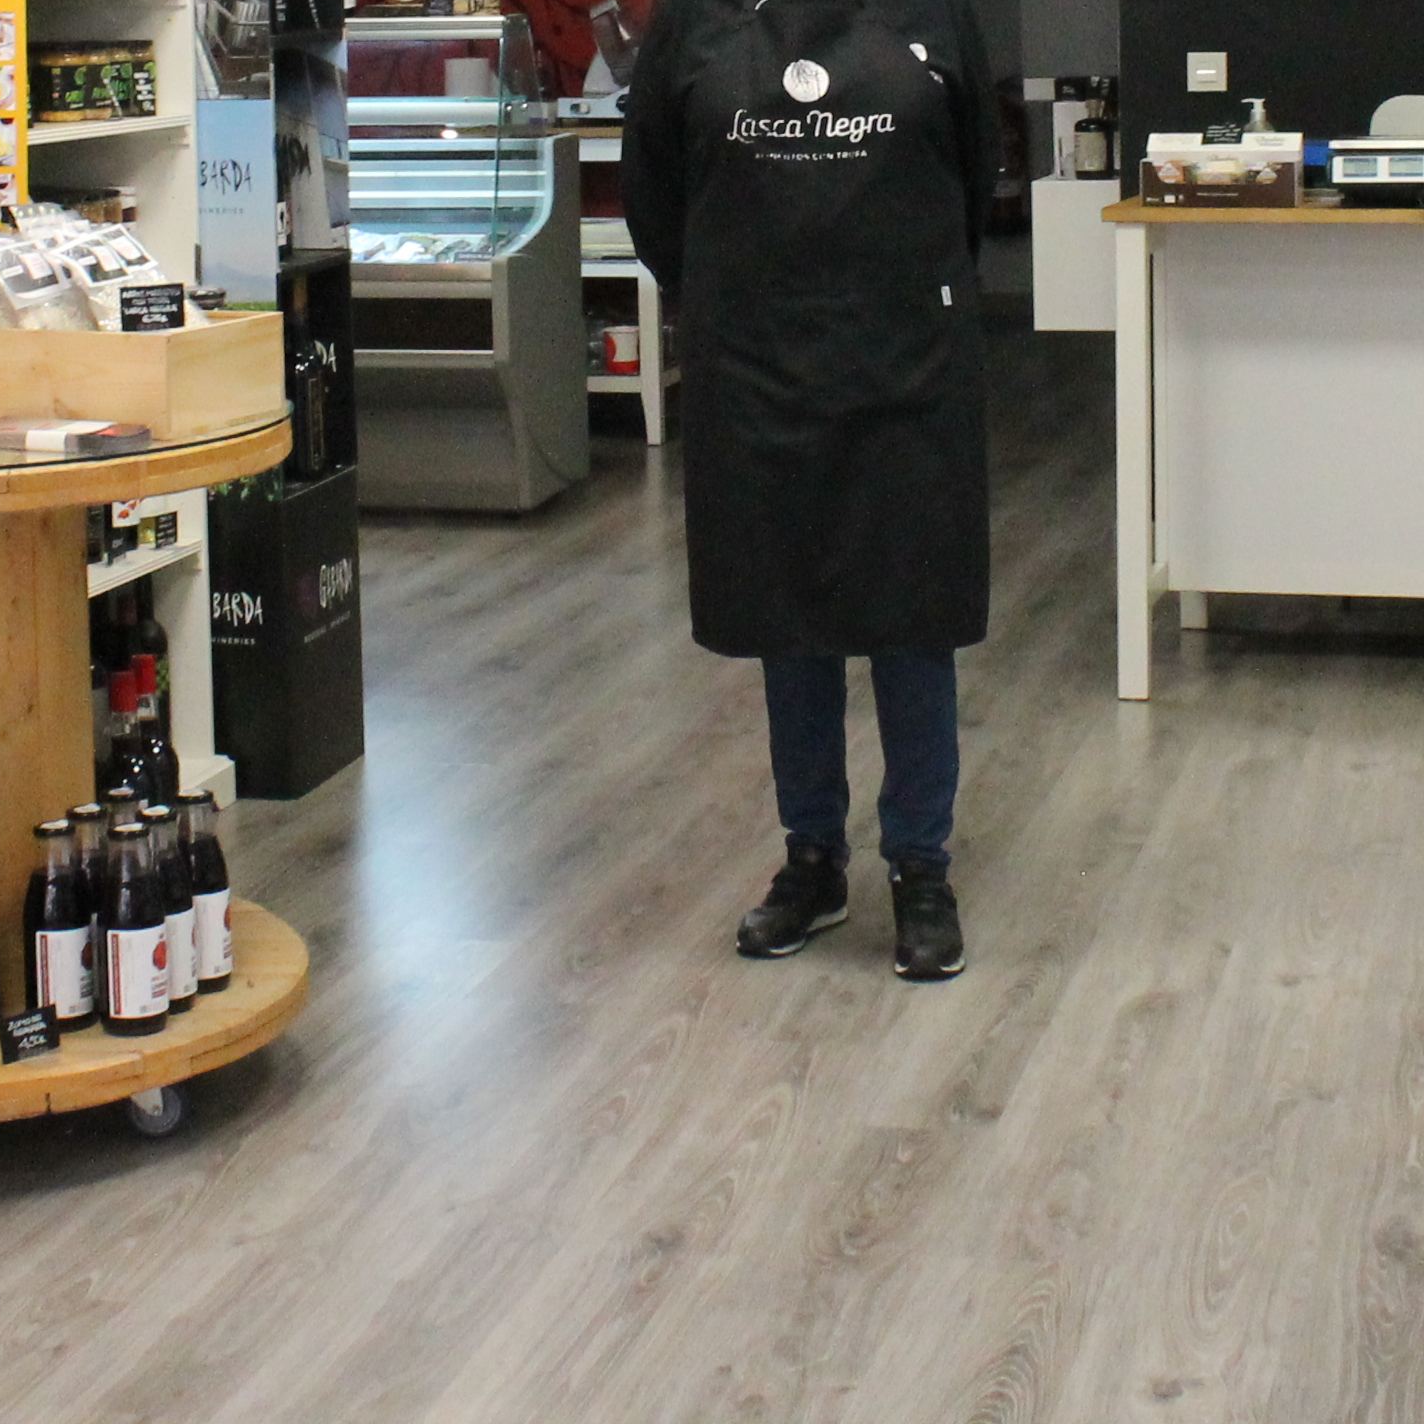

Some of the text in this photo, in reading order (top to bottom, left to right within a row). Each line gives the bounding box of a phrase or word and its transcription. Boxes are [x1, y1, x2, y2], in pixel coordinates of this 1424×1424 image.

[727, 108, 897, 144] Lasca Negra
[199, 159, 253, 196] BARDA
[212, 591, 264, 627] BARDA
